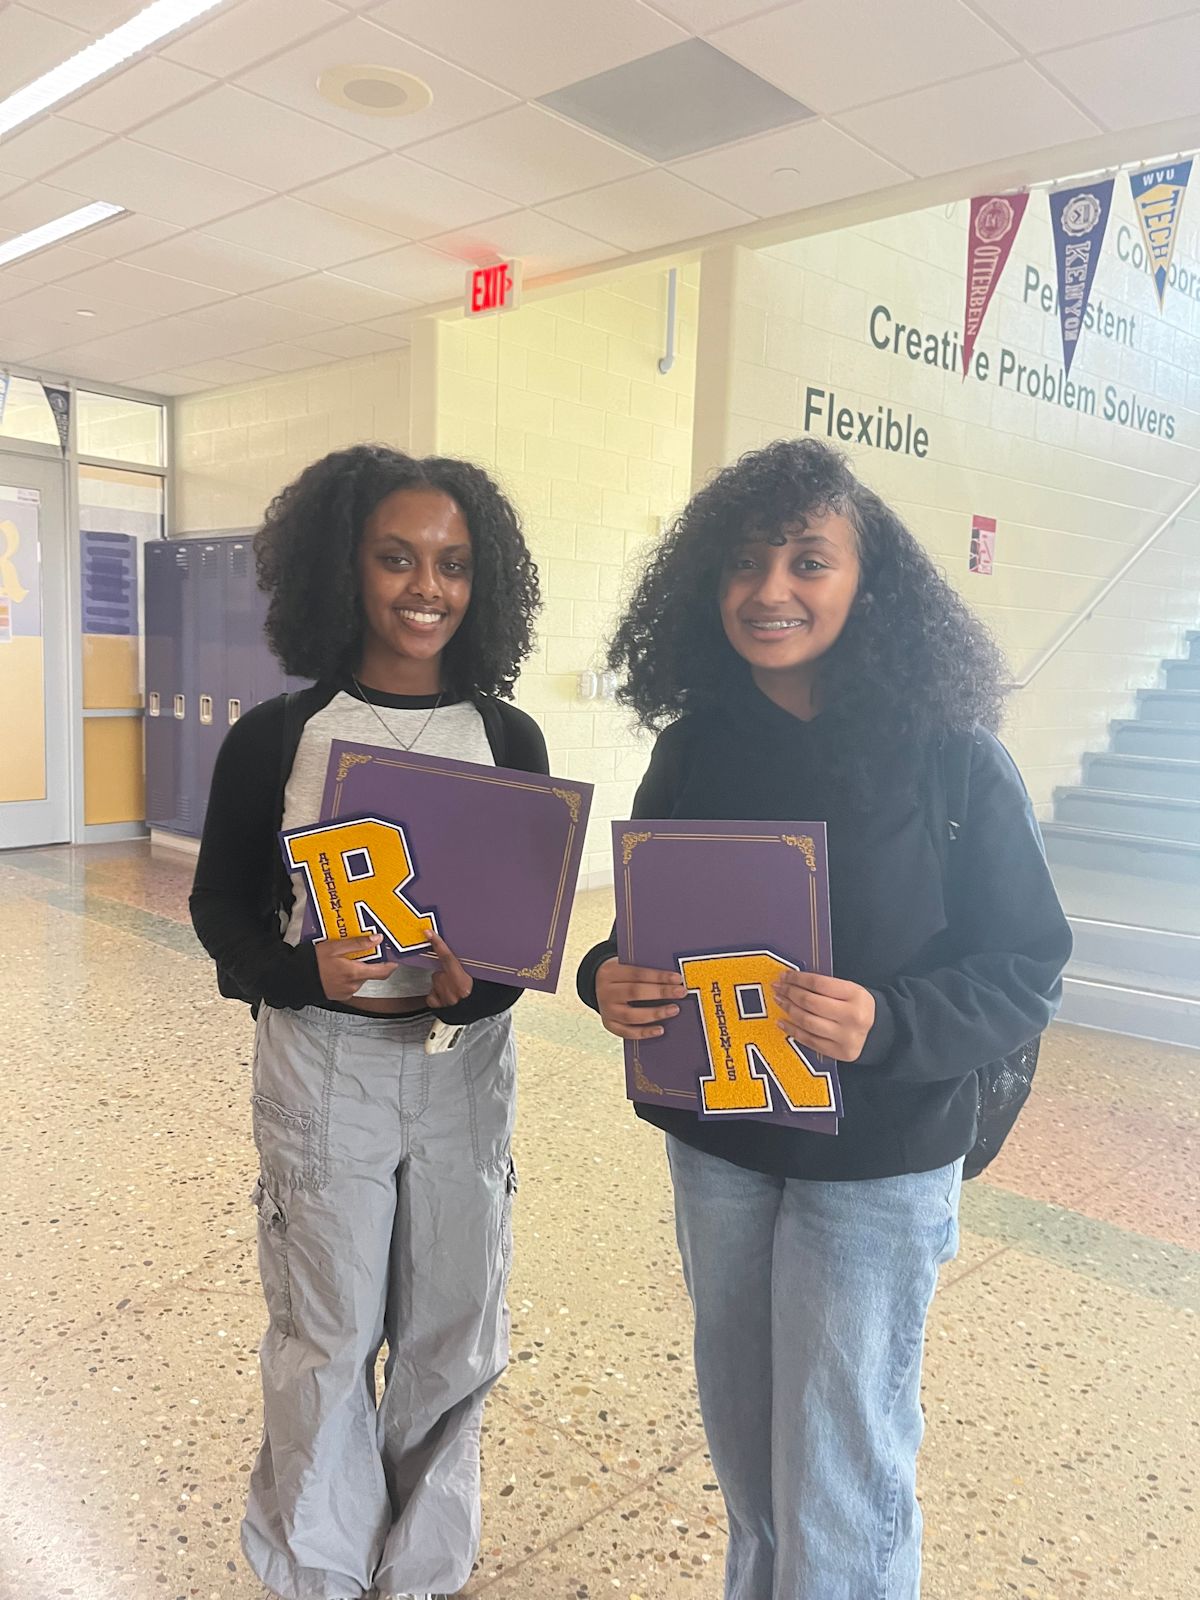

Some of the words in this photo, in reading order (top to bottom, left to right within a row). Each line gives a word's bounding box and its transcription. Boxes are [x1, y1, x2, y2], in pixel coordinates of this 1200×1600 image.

[1142, 168, 1175, 187] WVU
[1140, 189, 1180, 260] TECH
[471, 263, 508, 312] EXIT
[967, 245, 1002, 336] OTTERBEIN
[1064, 240, 1092, 341] KENYON
[870, 304, 989, 382] Creatie
[998, 348, 1096, 416] Problem
[1103, 385, 1176, 440] Solvers
[804, 387, 930, 459] Flexible
[284, 817, 438, 962] R
[318, 852, 348, 938] ACADEMICS
[678, 950, 836, 1115] R
[711, 981, 737, 1082] ACADEMICS
